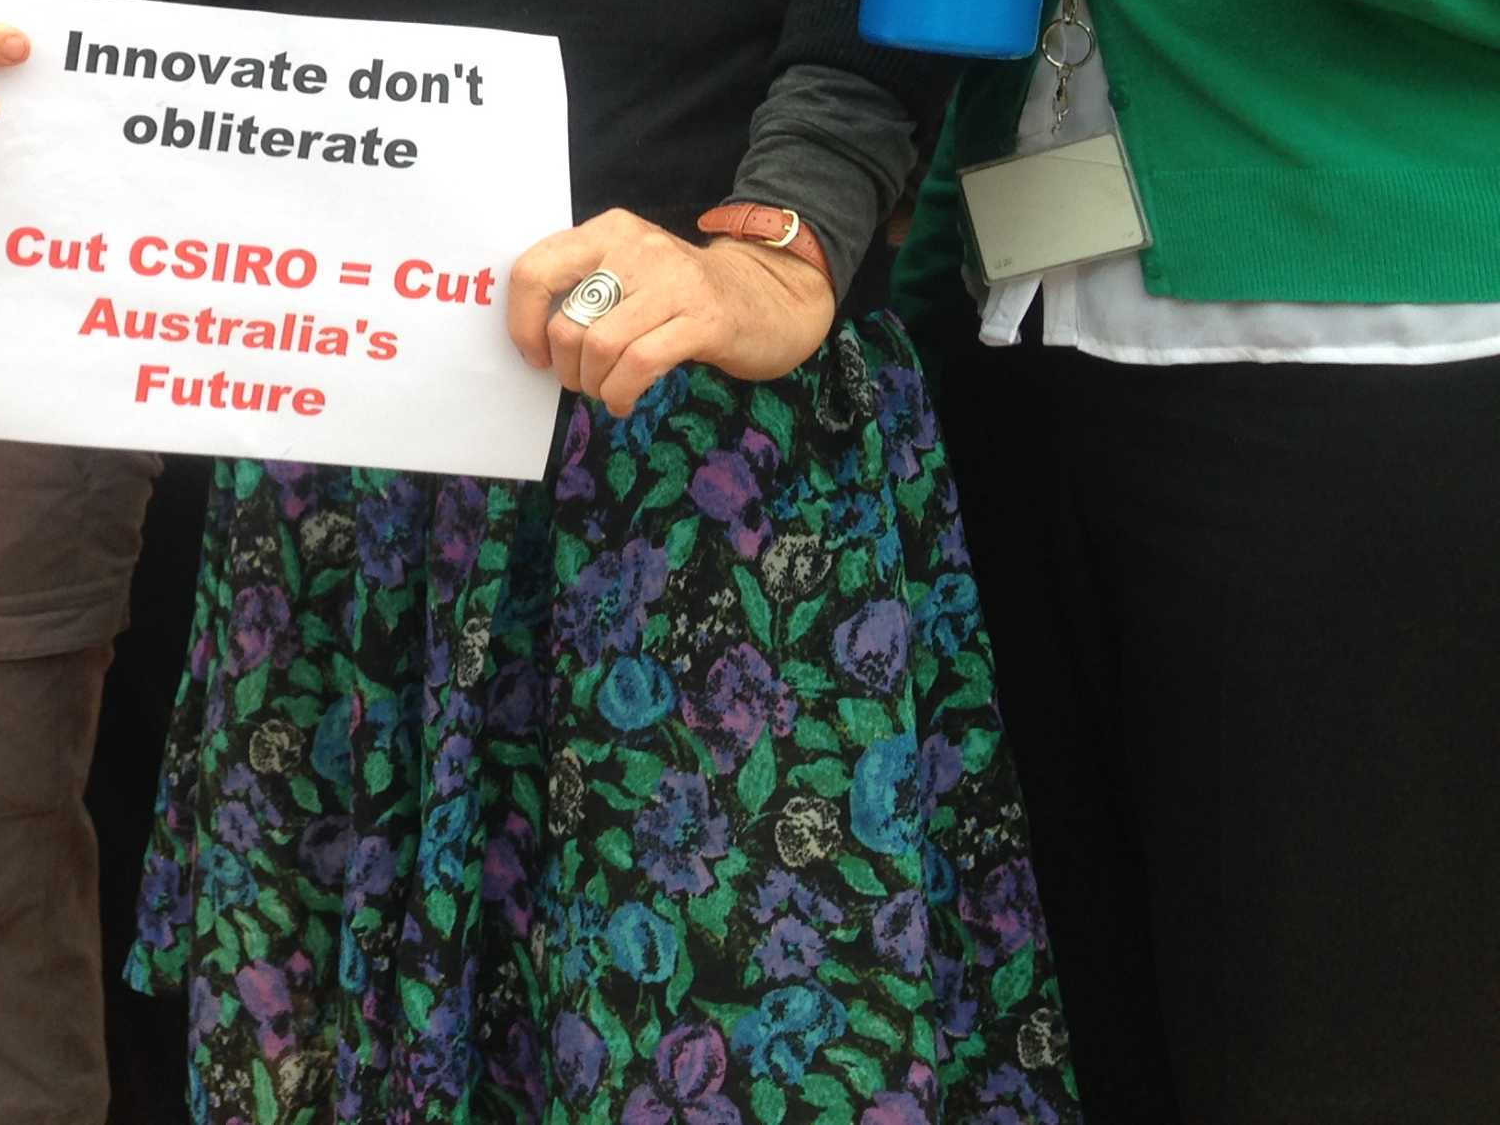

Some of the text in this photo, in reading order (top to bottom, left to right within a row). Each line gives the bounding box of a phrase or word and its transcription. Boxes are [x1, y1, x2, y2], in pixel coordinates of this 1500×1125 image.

[64, 30, 484, 106] Innovate don't
[122, 107, 418, 169] obliterate
[5, 226, 496, 306] Cut CSIRO = Cut
[78, 297, 398, 361] Australia's
[134, 364, 326, 417] Future
